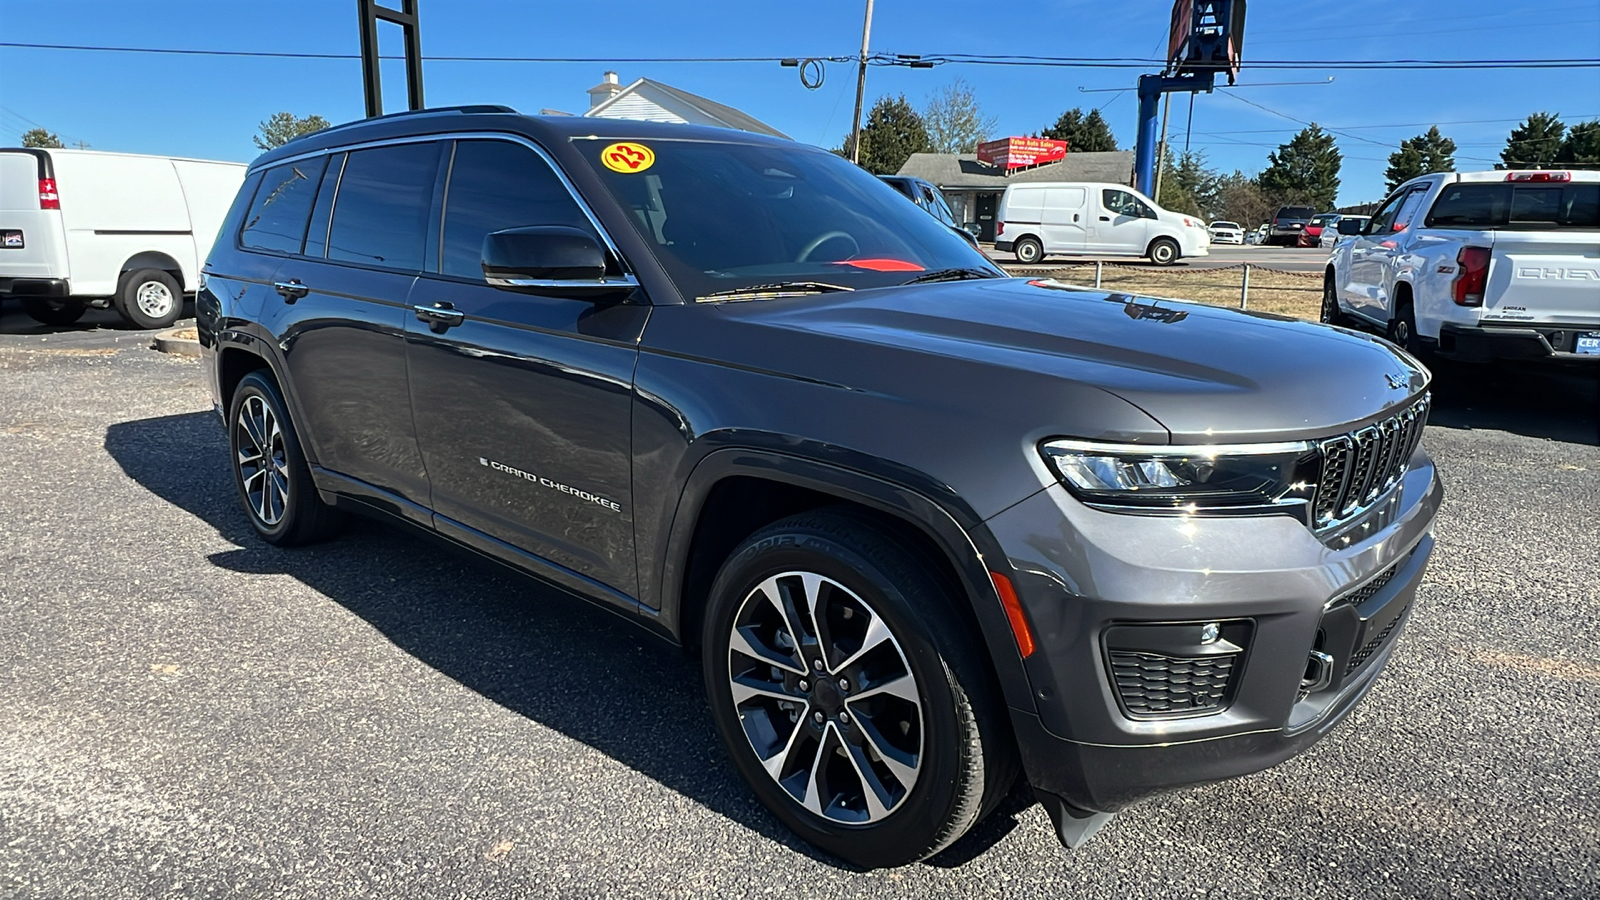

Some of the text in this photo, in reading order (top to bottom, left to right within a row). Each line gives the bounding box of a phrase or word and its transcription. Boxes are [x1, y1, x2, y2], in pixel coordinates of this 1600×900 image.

[1011, 138, 1025, 146] Value
[610, 145, 646, 169] 23
[1579, 338, 1600, 348] CER
[490, 461, 621, 513] GRAND CHEROKEE
